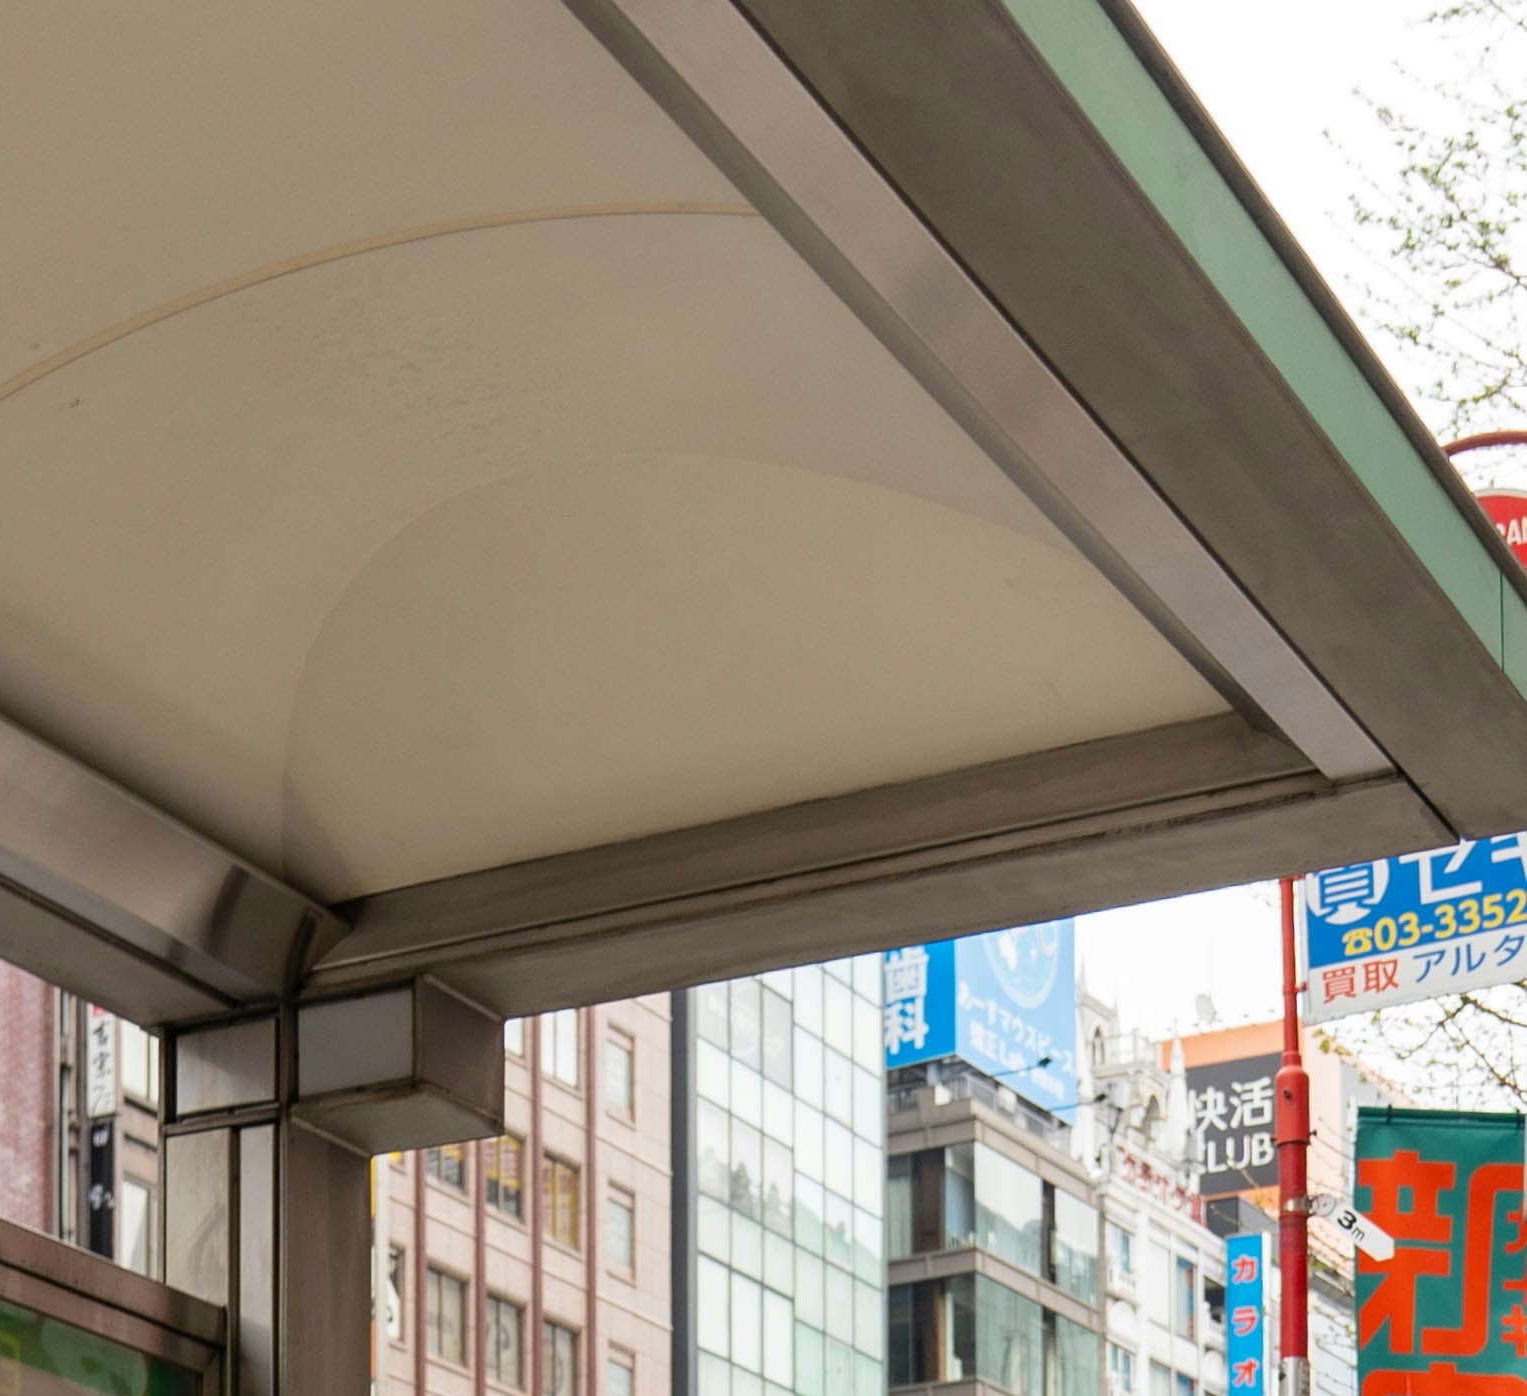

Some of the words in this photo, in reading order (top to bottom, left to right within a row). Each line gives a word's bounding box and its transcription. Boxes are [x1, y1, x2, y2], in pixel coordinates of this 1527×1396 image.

[1322, 959, 1399, 1003] 買取
[1190, 1075, 1274, 1133] 快活
[1206, 1131, 1274, 1174] LUB
